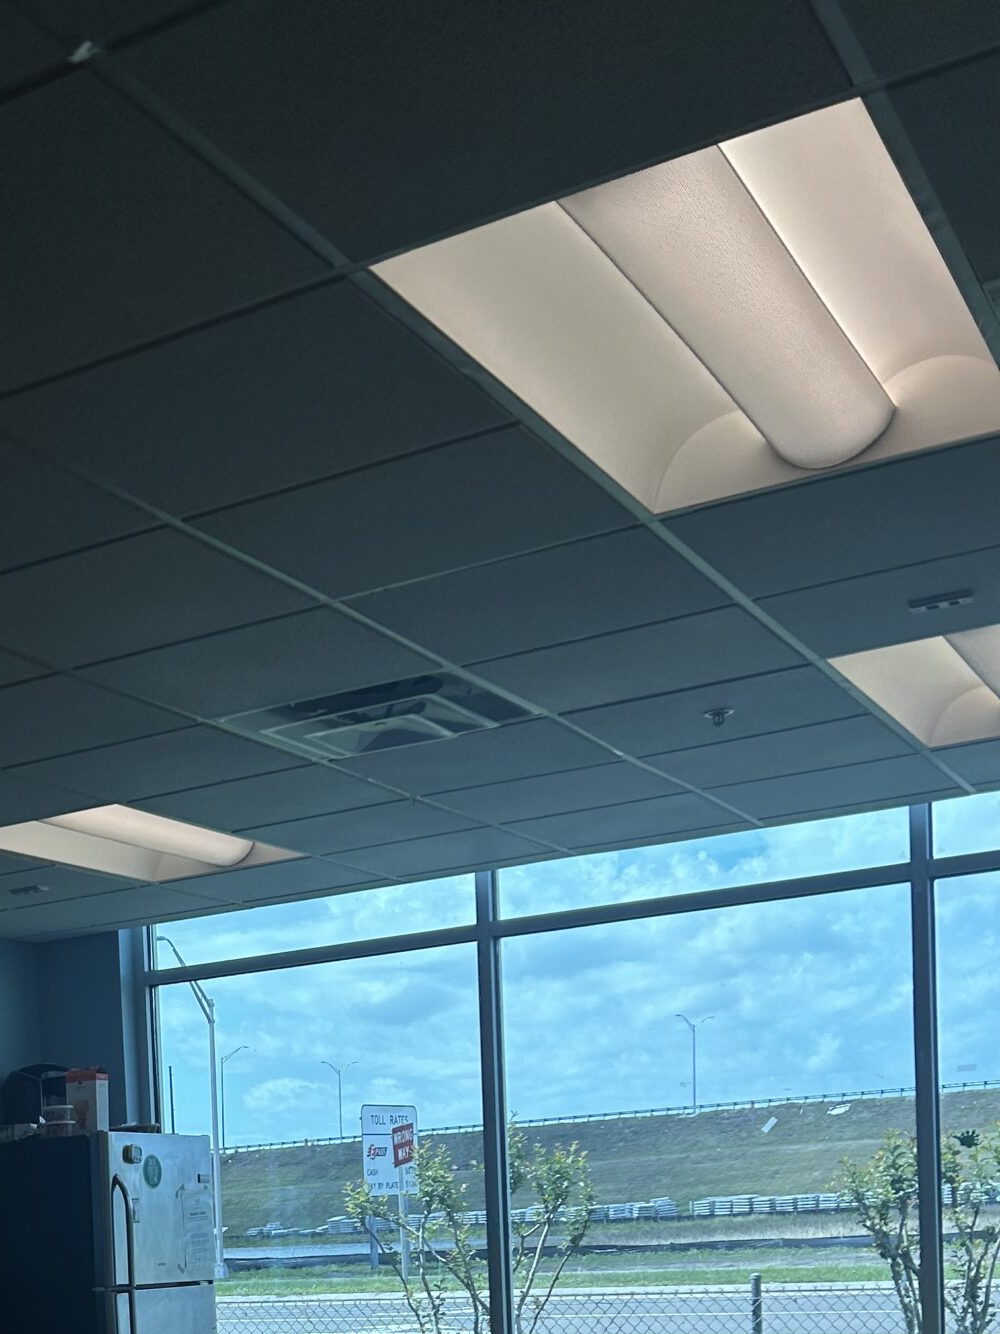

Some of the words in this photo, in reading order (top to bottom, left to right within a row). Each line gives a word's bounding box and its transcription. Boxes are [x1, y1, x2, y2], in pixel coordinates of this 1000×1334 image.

[370, 1115, 386, 1125] TOLL
[390, 1115, 409, 1124] RATES
[393, 1128, 413, 1145] WRONG
